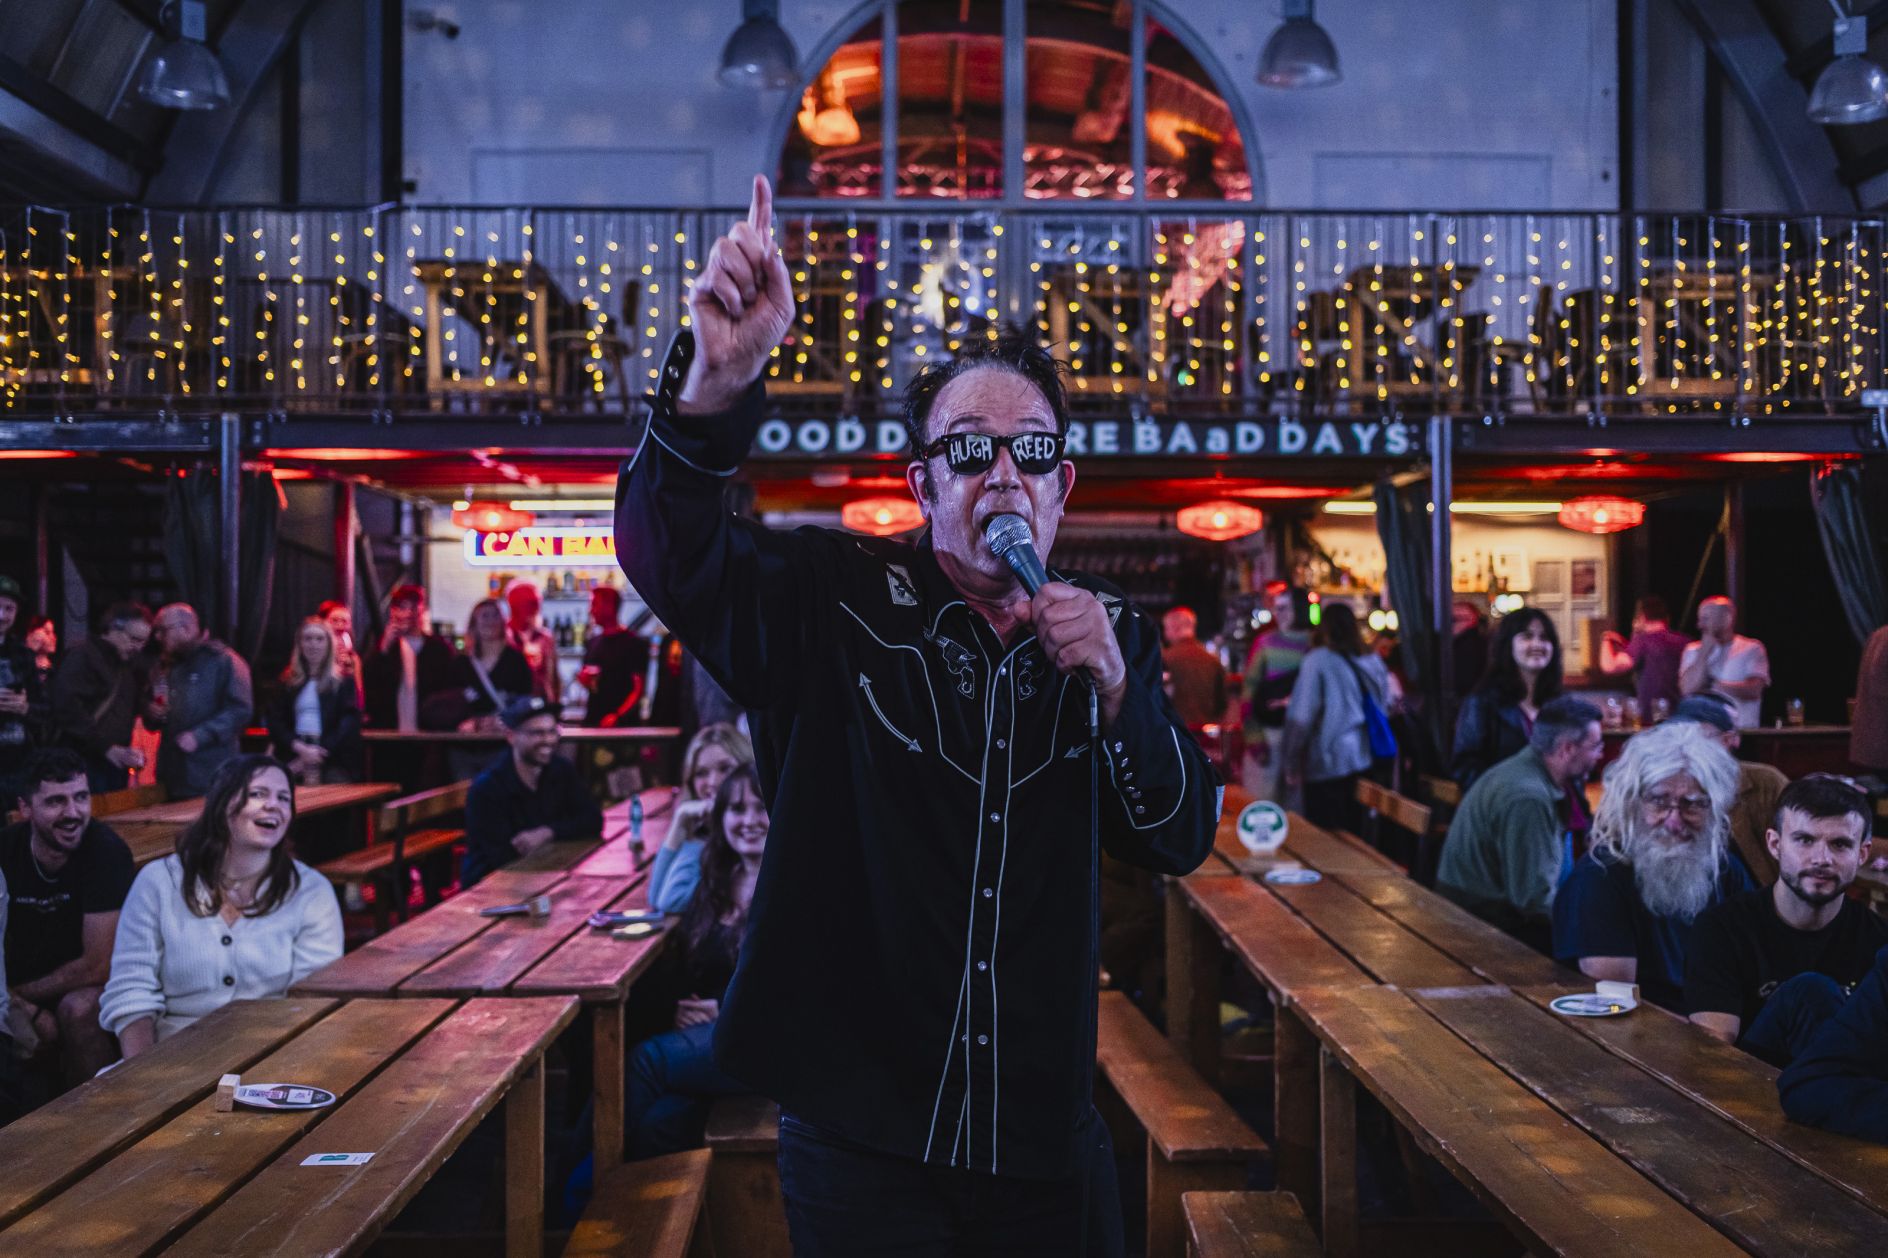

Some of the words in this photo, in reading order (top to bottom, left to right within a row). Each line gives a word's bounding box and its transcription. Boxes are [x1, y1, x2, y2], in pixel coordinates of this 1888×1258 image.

[759, 419, 866, 452] OOD
[1063, 420, 1120, 454] RE
[1278, 421, 1409, 455] DAYS
[950, 437, 993, 464] HUGH
[1012, 434, 1056, 462] REED
[482, 531, 553, 556] CAN
